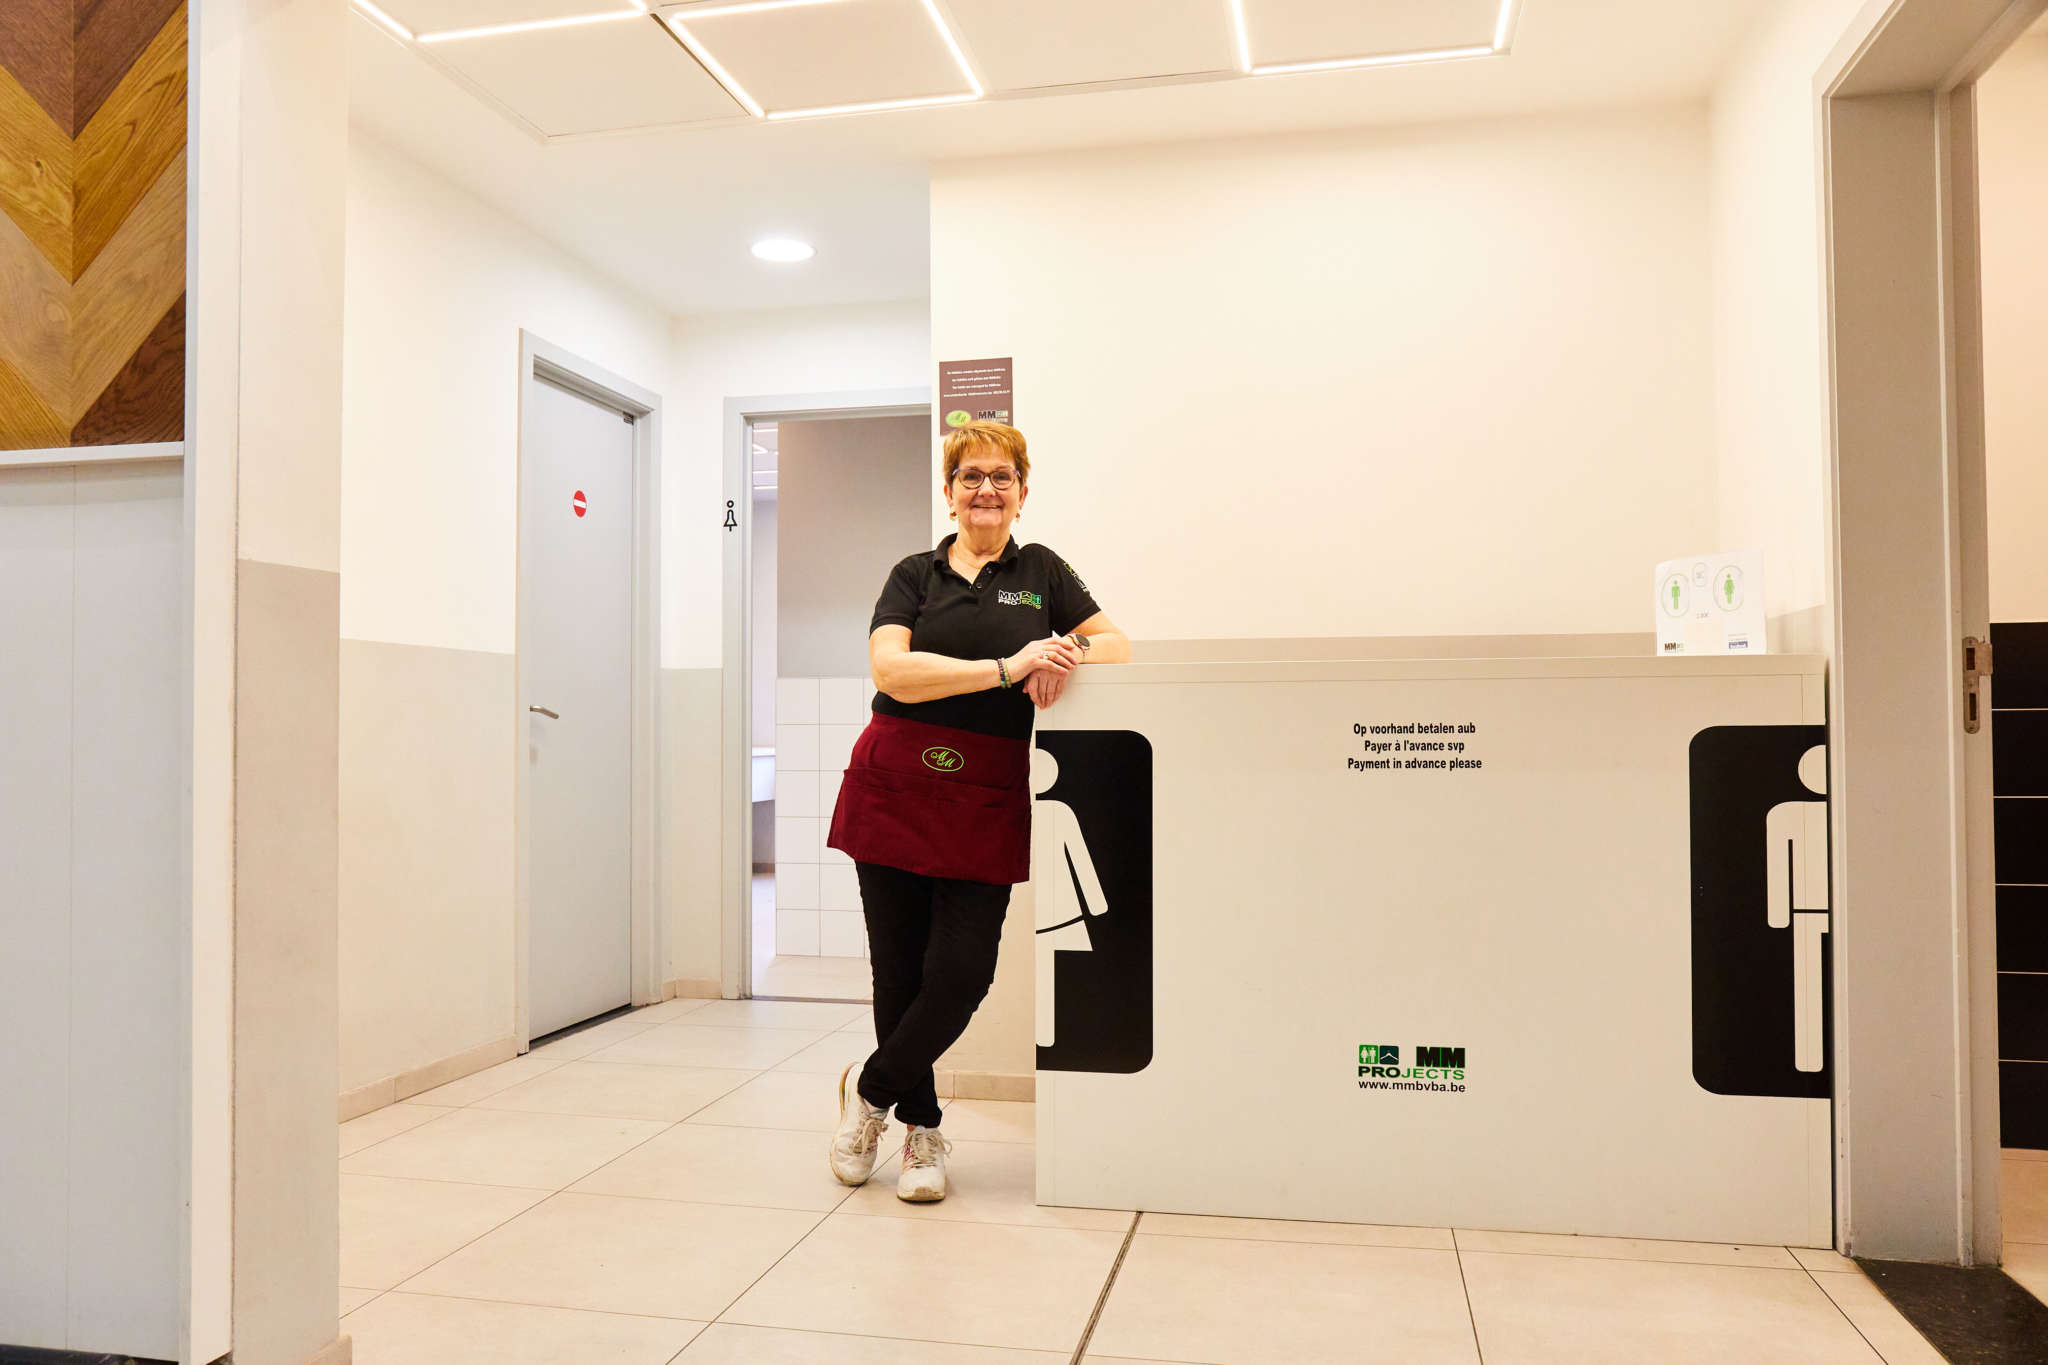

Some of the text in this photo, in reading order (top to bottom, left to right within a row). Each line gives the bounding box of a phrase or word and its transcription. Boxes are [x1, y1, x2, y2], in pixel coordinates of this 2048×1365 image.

[978, 410, 996, 419] MM
[998, 589, 1020, 601] MM
[1353, 722, 1476, 737] Op voorhand betalen aub
[1364, 740, 1392, 754] Payer
[1403, 740, 1445, 751] l'avance
[1447, 741, 1465, 754] svp
[1347, 757, 1482, 772] Payment in advance please
[1415, 1046, 1466, 1068] MM
[1358, 1066, 1465, 1080] PROJECTS
[1358, 1080, 1466, 1093] www.mmbvba.be
